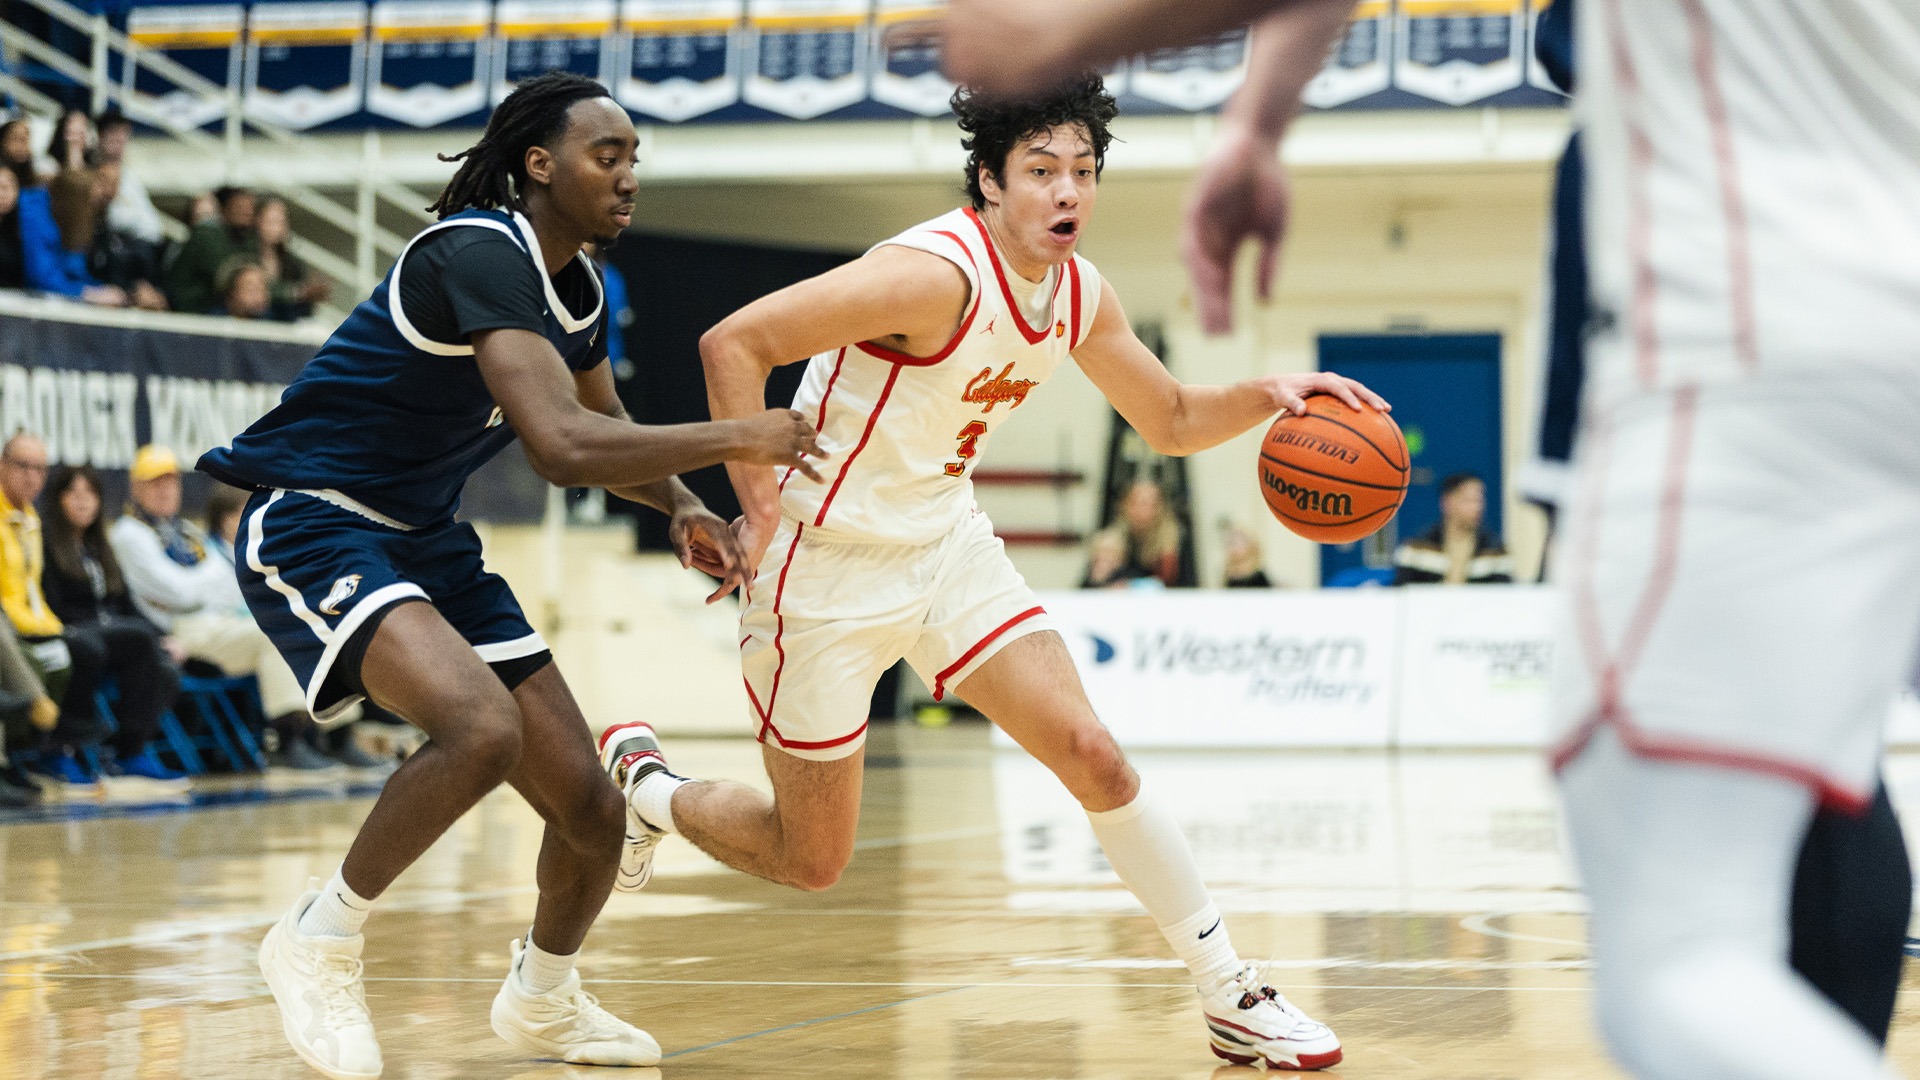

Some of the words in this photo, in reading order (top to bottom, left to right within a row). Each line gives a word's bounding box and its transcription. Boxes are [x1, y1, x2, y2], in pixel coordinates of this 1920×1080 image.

[961, 361, 1039, 413] Calgary
[943, 420, 987, 477] 3
[1272, 431, 1360, 464] EVOLUTION
[1264, 466, 1353, 516] Wilson
[1132, 629, 1368, 675] Western
